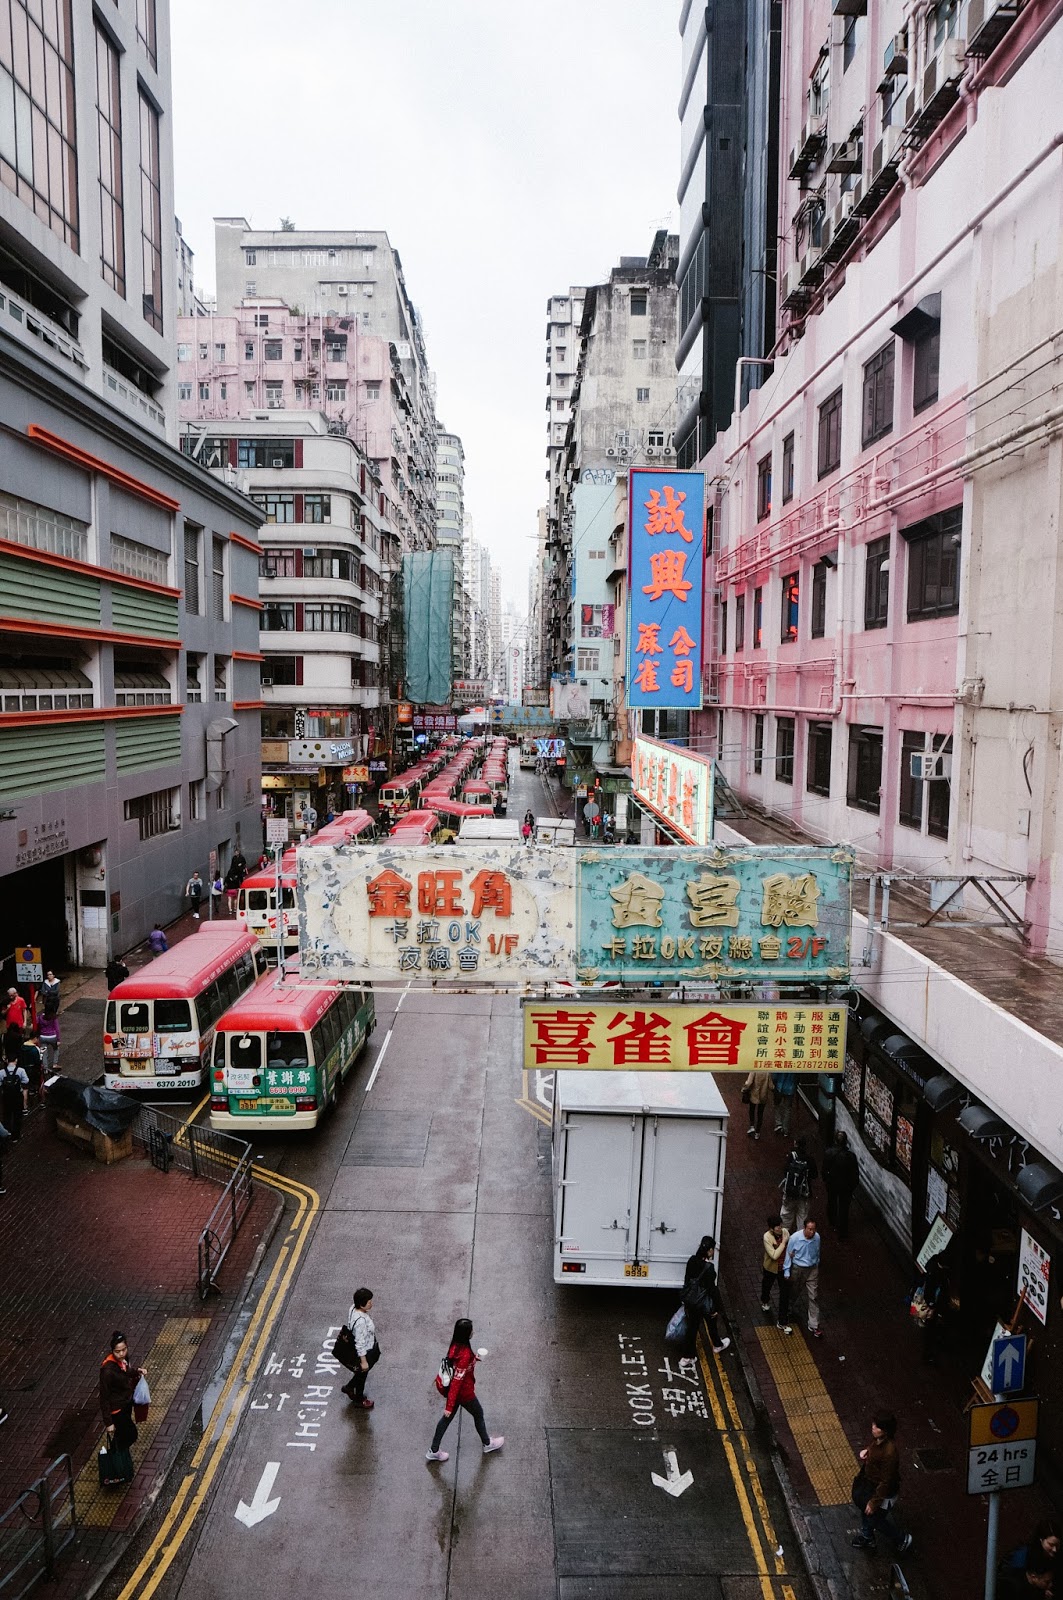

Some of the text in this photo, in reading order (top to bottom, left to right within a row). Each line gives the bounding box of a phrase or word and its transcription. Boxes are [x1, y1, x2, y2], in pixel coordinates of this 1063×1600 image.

[642, 486, 694, 602] 誠興
[668, 626, 697, 694] 公司
[330, 742, 351, 755] SALON
[367, 868, 513, 918] 金旺角
[487, 932, 519, 955] 1/F
[398, 946, 481, 972] 夜總會
[530, 1010, 748, 1065] 喜雀會
[157, 1080, 175, 1088] 6370
[977, 1447, 1028, 1465] 24 hrs
[981, 1465, 1022, 1488] 全日
